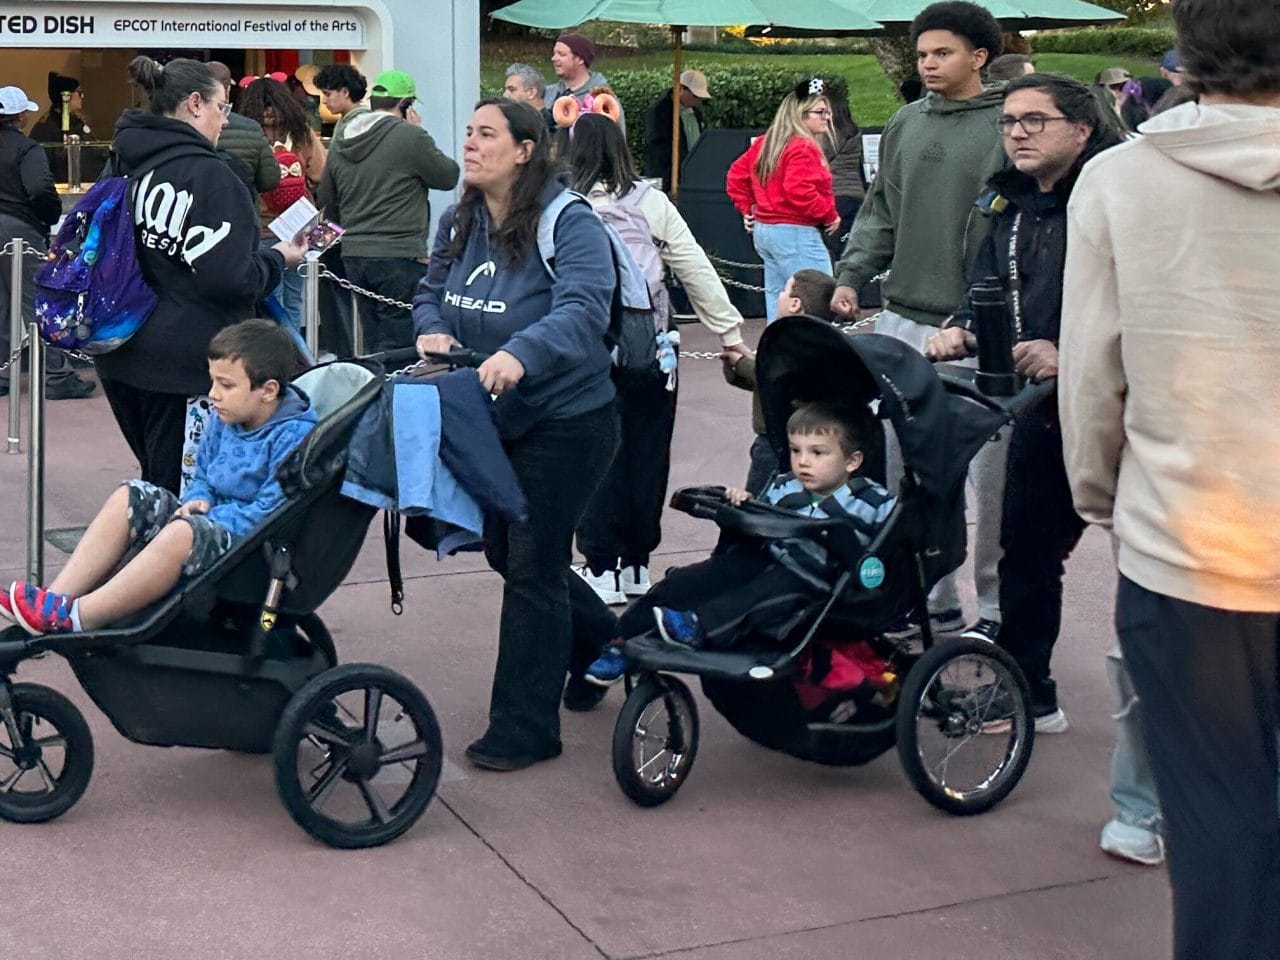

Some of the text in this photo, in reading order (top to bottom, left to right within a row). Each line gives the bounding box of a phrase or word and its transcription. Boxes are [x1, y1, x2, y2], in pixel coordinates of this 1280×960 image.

[44, 15, 95, 34] DISH
[113, 19, 357, 32] EPCOT International Festival of the Arts
[1009, 234, 1018, 257] YORK
[1009, 259, 1018, 280] CITY
[444, 291, 507, 314] HEAD
